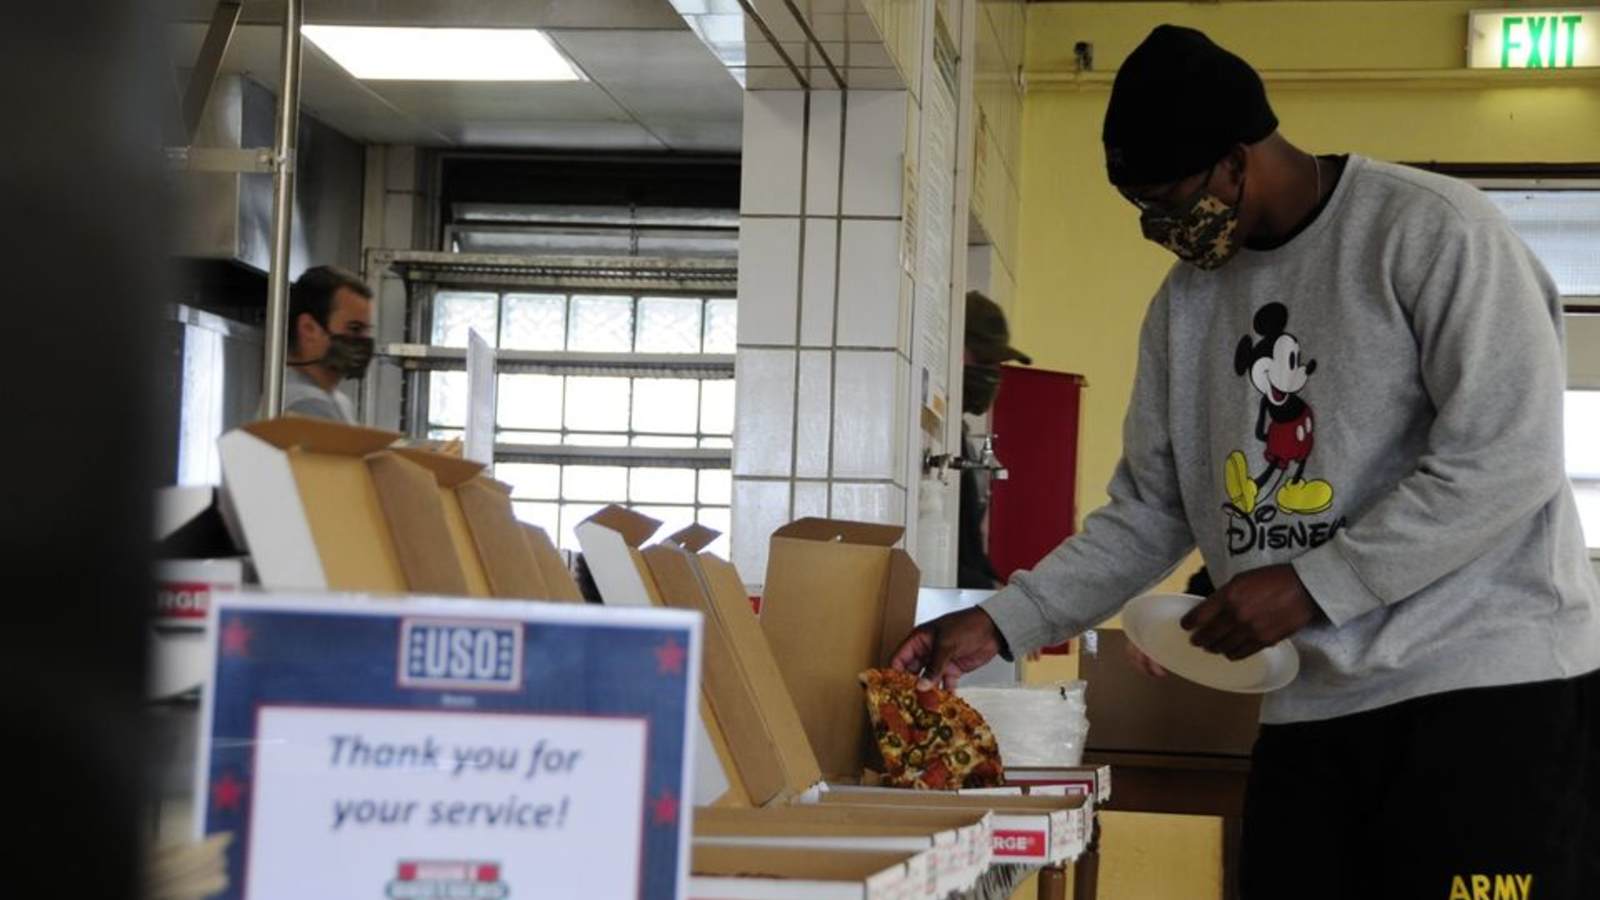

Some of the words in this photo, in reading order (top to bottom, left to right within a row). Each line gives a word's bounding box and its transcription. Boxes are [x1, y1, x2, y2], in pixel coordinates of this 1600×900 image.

[1501, 15, 1582, 69] EXIT
[425, 628, 498, 678] USO
[329, 734, 441, 768] Thank
[451, 746, 519, 777] you
[524, 738, 584, 780] for
[330, 798, 418, 832] your
[428, 793, 572, 829] service!
[1450, 873, 1533, 900] ARMY
